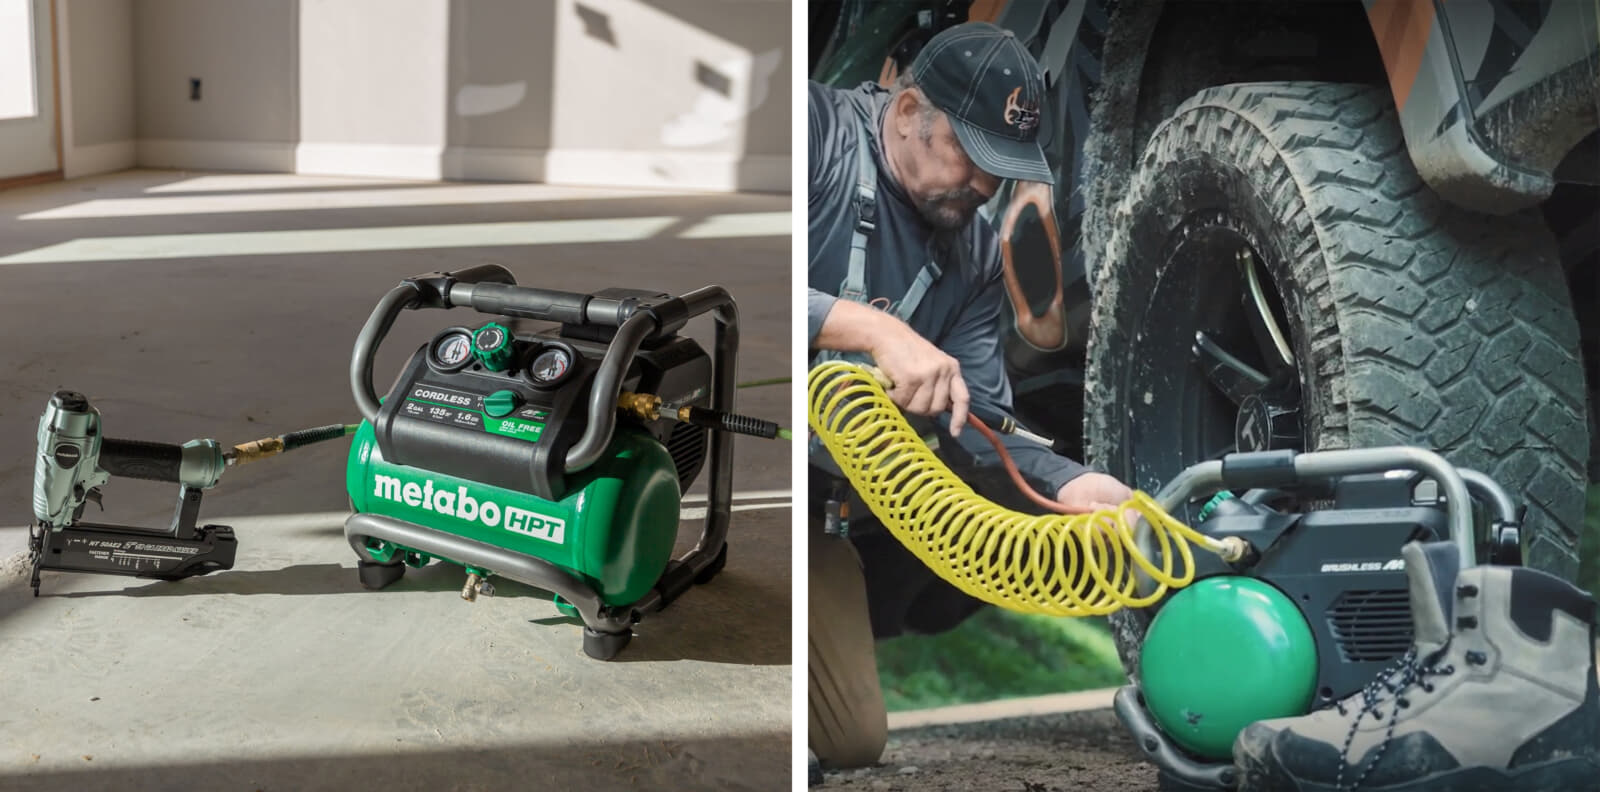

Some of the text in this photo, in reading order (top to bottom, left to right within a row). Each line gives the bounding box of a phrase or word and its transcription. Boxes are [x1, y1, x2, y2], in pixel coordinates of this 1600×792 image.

[414, 388, 472, 407] CORDLESS
[502, 420, 516, 430] OIL
[518, 423, 543, 434] FREE
[373, 473, 562, 539] metabo HPT
[1320, 562, 1383, 573] BRUSHLESS
